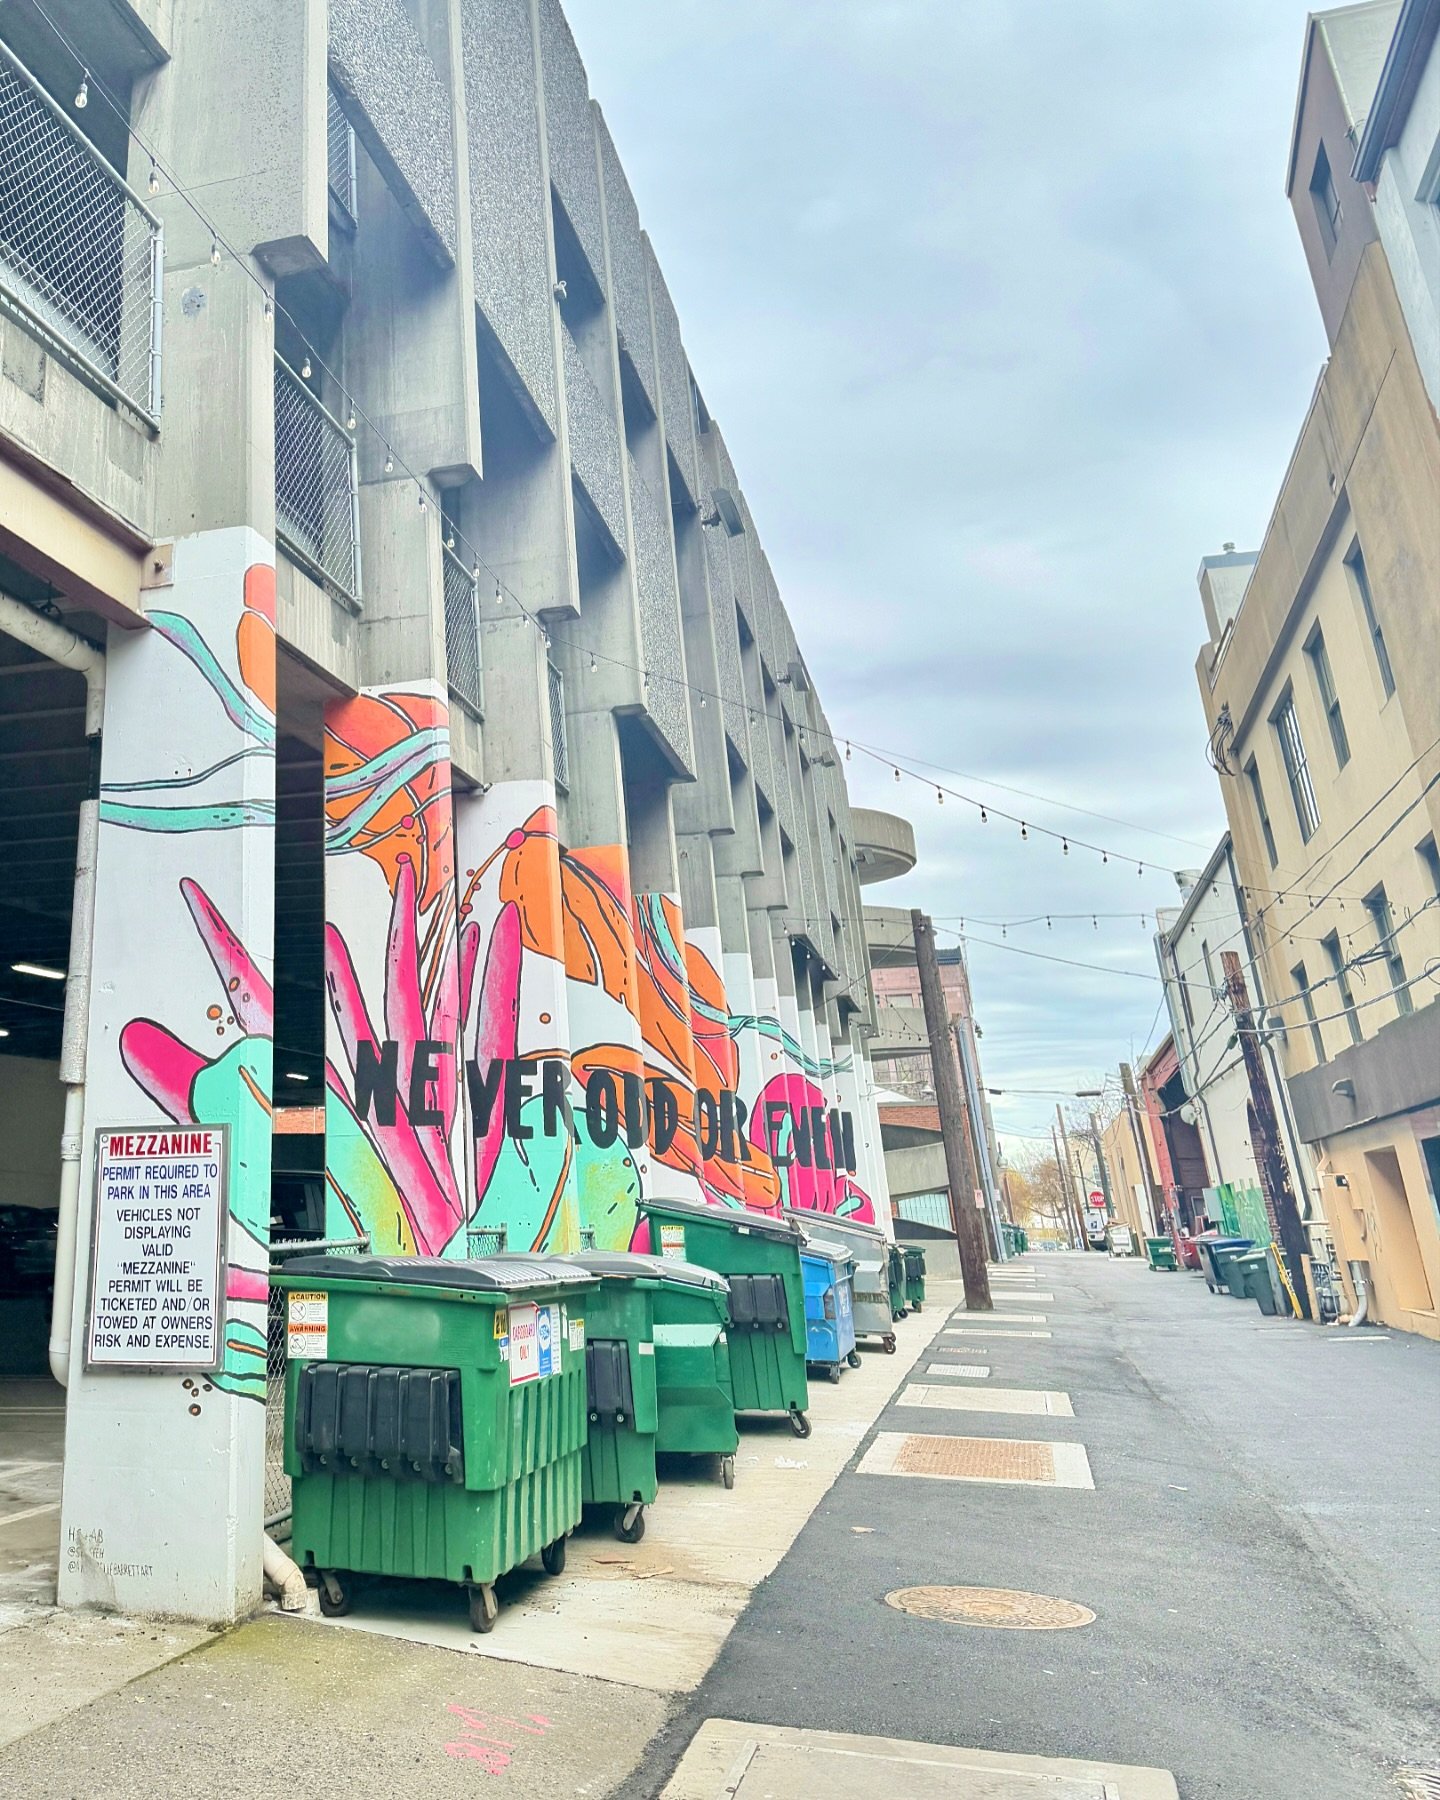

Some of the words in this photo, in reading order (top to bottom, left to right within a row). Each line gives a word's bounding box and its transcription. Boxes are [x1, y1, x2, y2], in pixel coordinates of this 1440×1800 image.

[354, 1040, 582, 1145] NEVER
[694, 1087, 752, 1163] OR
[763, 1100, 856, 1172] EVEN
[109, 1133, 213, 1157] MEZZANINE
[102, 1165, 142, 1181] PERMIT
[145, 1164, 199, 1180] REQUIRED
[203, 1163, 218, 1178] TO
[107, 1185, 134, 1200] PARK
[139, 1185, 150, 1200] IN
[154, 1184, 178, 1199] THIS
[182, 1183, 211, 1198] AREA
[1091, 1195, 1104, 1203] STOP
[116, 1208, 172, 1222] VEHICLES
[177, 1207, 201, 1221] NOT
[124, 1225, 191, 1239] DISPLAYING
[142, 1243, 173, 1257] VALID
[117, 1261, 196, 1275] "MEZZANINE"
[108, 1279, 151, 1293] PERMIT
[155, 1279, 183, 1293] WILL
[188, 1279, 203, 1292] BE
[100, 1297, 157, 1311] TICKETED
[161, 1297, 210, 1311] AND/OR
[96, 1316, 138, 1330] TOWED
[142, 1316, 156, 1329] AT
[161, 1316, 213, 1330] OWNERS
[294, 1325, 326, 1333] WARNING
[94, 1334, 122, 1348] RISK
[126, 1334, 151, 1348] AND
[155, 1334, 213, 1349] EXPENSE.
